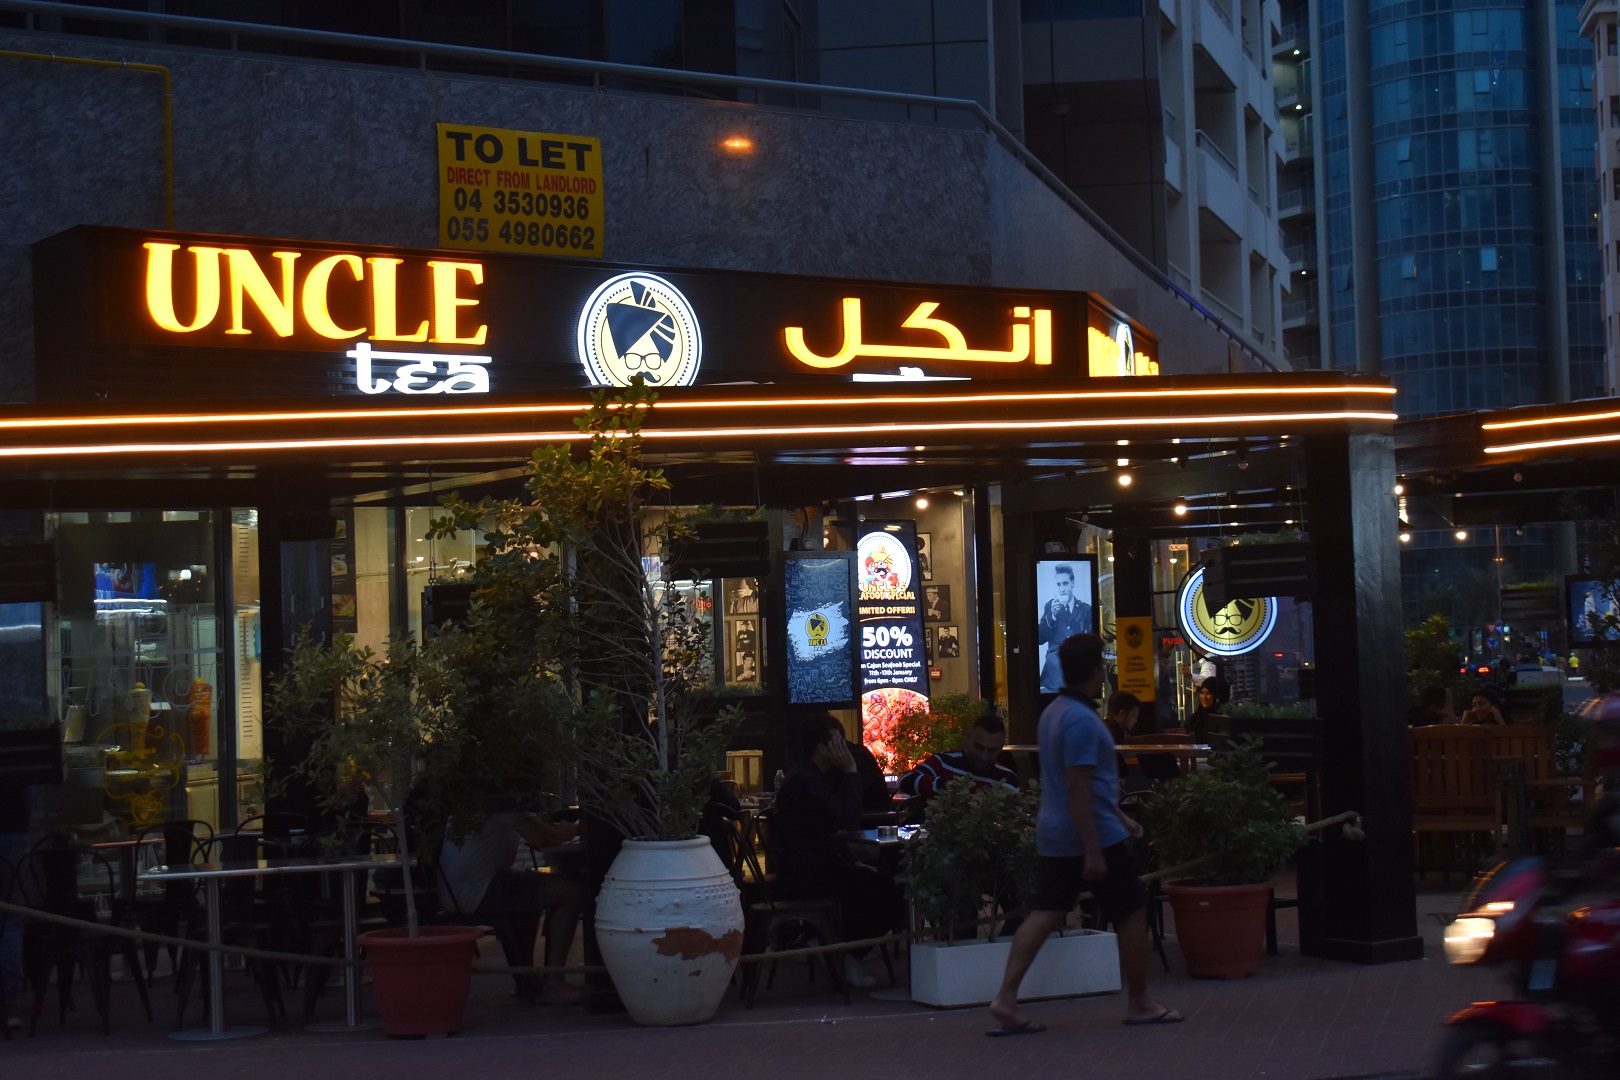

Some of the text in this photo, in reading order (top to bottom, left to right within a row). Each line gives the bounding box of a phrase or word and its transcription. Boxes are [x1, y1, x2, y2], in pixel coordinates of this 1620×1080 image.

[446, 131, 592, 171] TO LET
[447, 166, 596, 195] DIRECT FROM LANDLORD
[454, 187, 589, 220] 04 3530936
[447, 216, 595, 250] 055 4980662
[143, 242, 488, 346] UNCLE
[346, 342, 492, 394] tea
[859, 591, 916, 601] AFOOD SPECIAL
[860, 581, 907, 593] UNCLE'S
[859, 606, 886, 615] IMITED
[862, 626, 913, 648] 50%
[1162, 637, 1185, 645] PUSH
[863, 649, 913, 660] DISCOUNT
